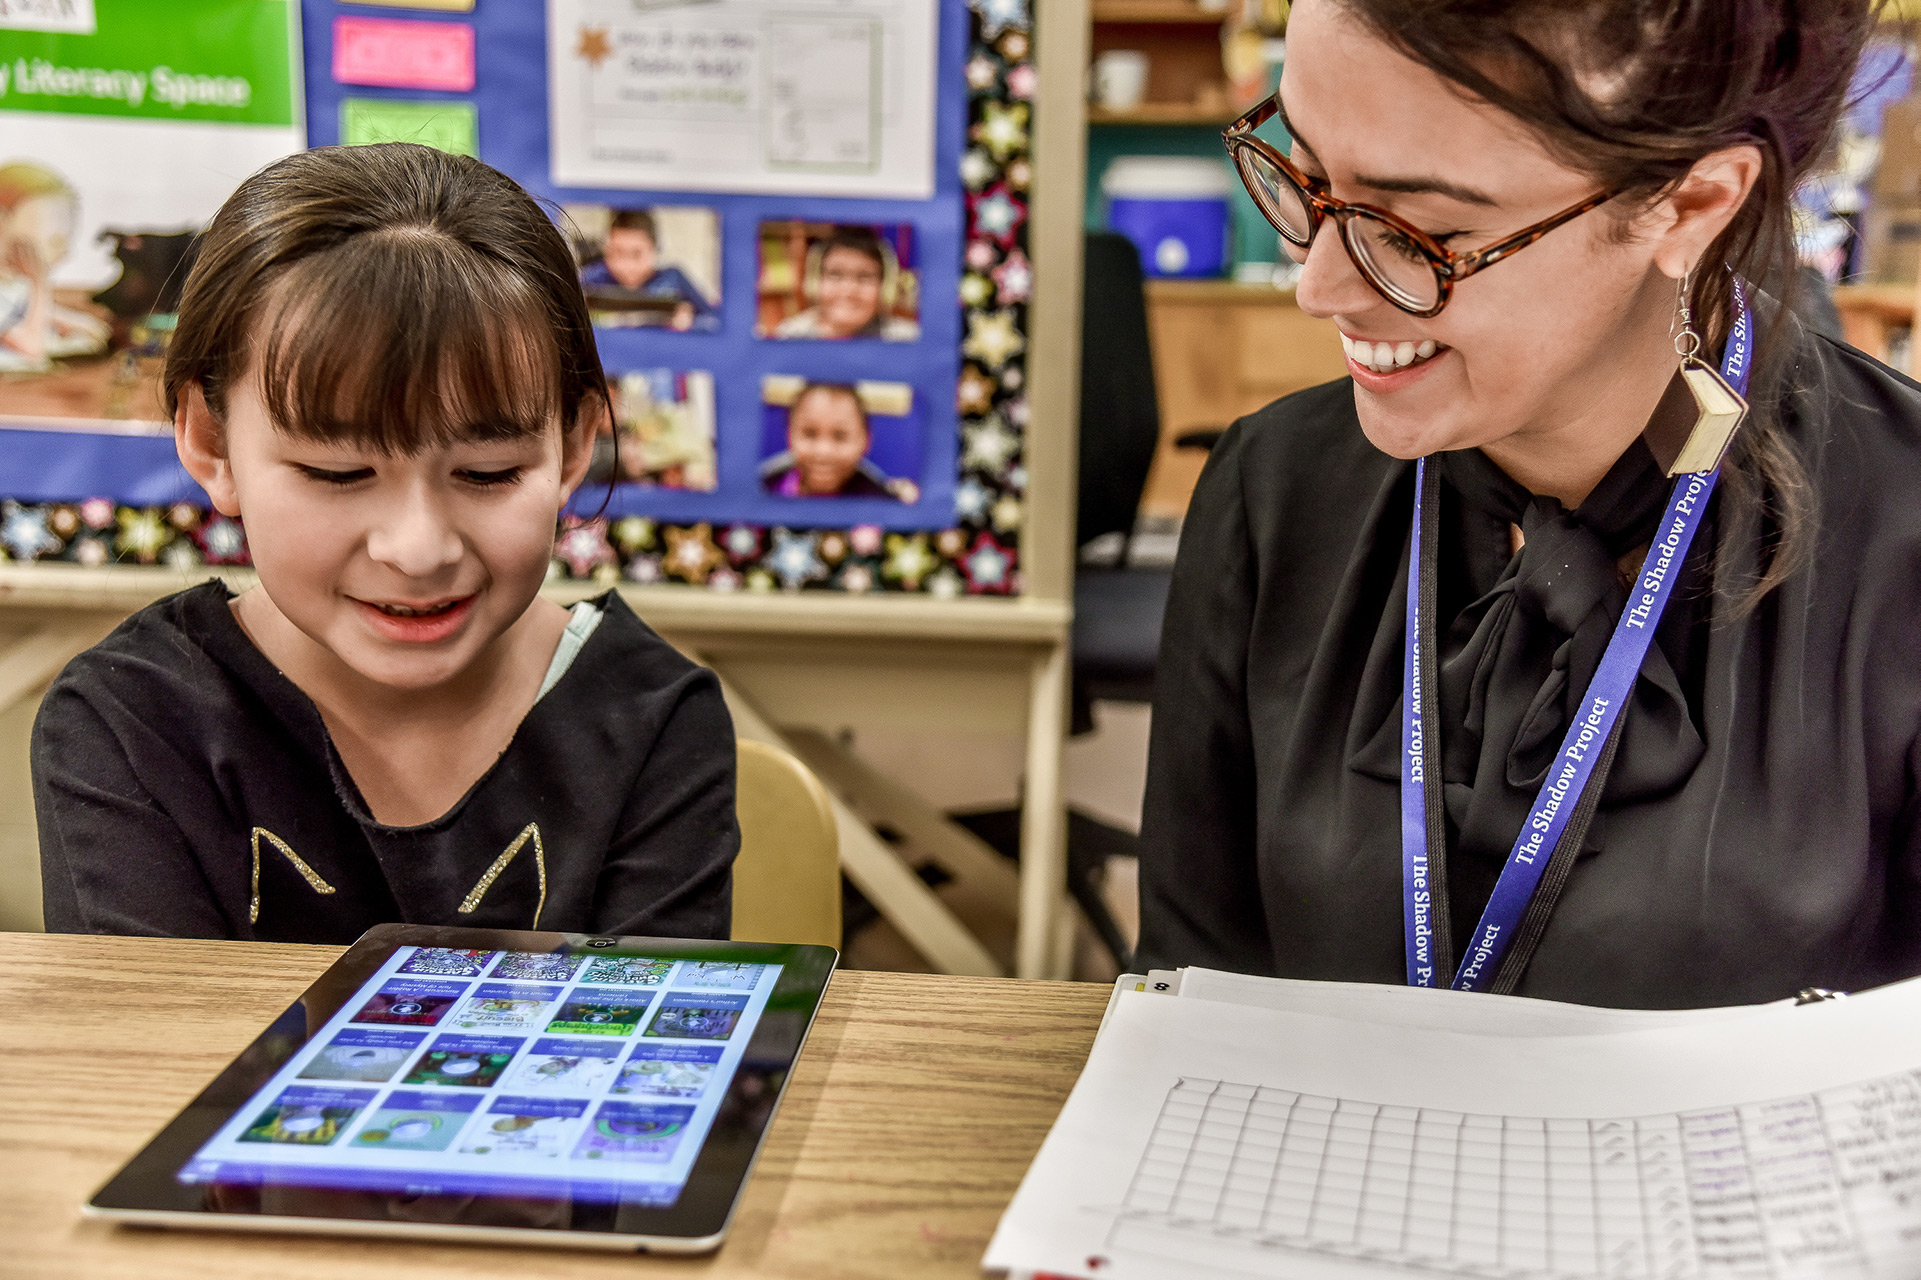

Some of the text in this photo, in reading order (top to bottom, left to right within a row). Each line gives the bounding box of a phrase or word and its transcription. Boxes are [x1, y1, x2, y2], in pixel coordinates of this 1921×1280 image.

[14, 57, 147, 107] Literacy
[150, 65, 250, 109] Space
[1727, 342, 1745, 377] The
[1626, 469, 1708, 629] The Shadow Proje
[1408, 718, 1424, 784] Project
[1515, 696, 1610, 865] The Shadow Project
[1413, 854, 1428, 889] The
[1413, 890, 1432, 963] Shadow
[1463, 924, 1501, 979] Project
